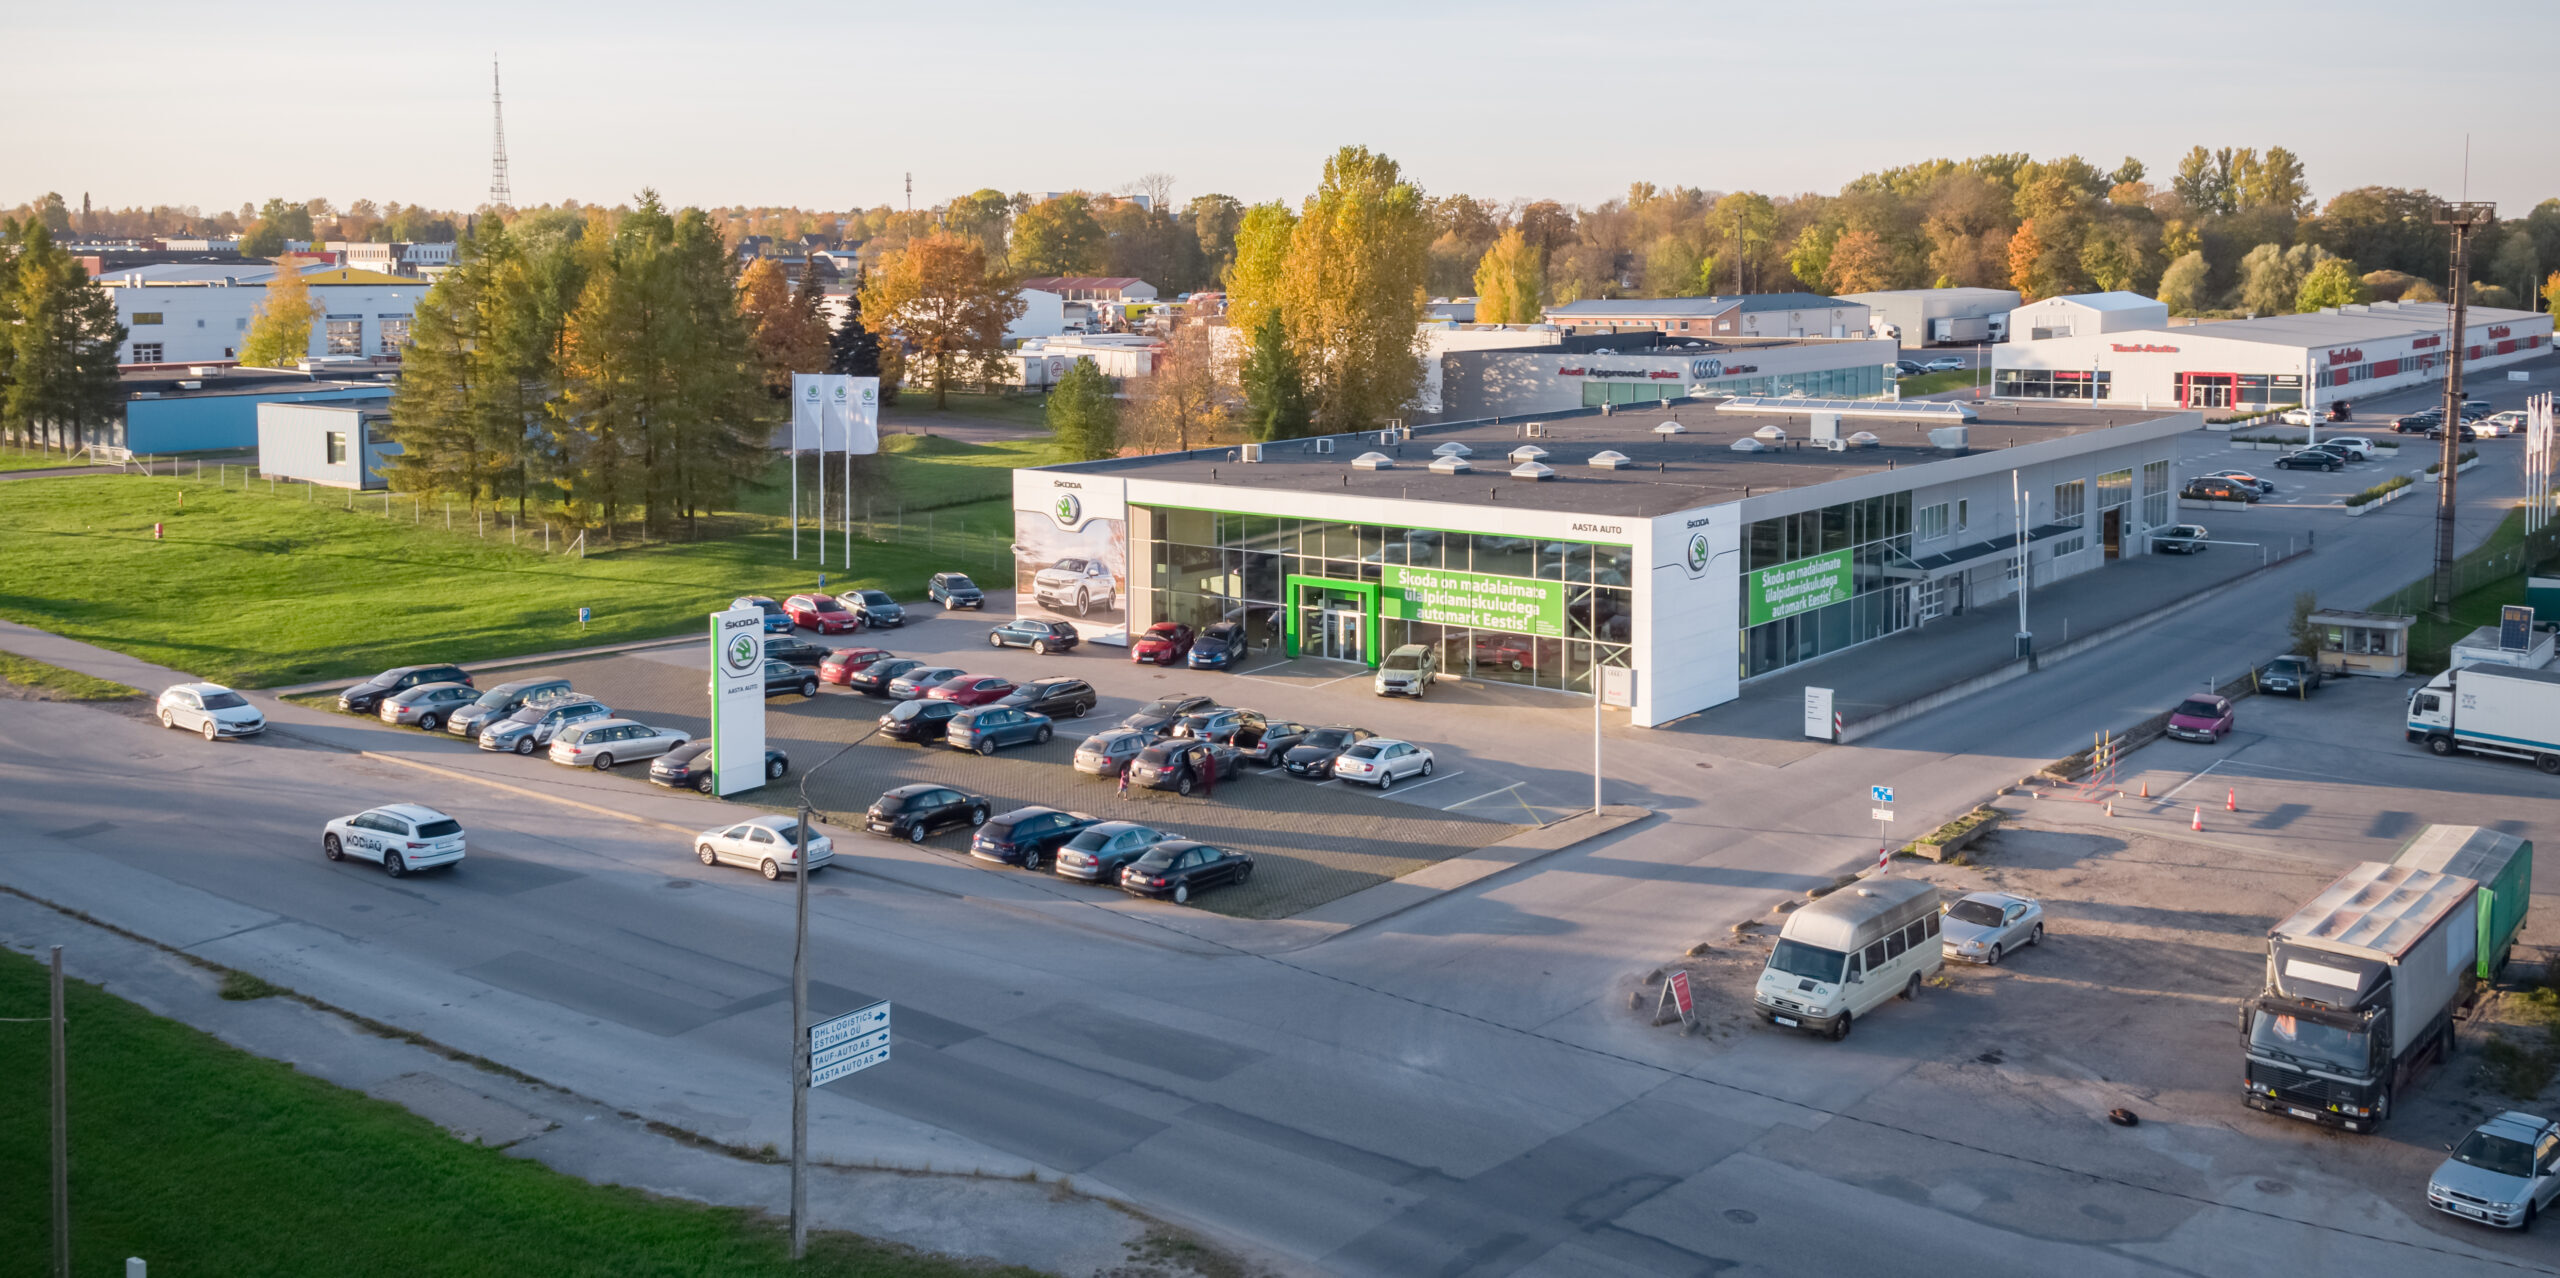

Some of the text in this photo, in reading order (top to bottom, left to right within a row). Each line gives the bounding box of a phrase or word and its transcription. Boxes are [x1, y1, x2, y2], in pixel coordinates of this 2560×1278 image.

[1558, 367, 1585, 376] Audi
[1588, 368, 1646, 378] Approved
[1572, 523, 1622, 534] AASTA AUTO
[1398, 568, 1547, 600] Škoda on madalaimate
[1762, 558, 1841, 588] Škoda on madalaimate
[1405, 587, 1540, 618] ülalpidamiskuludega
[1765, 574, 1838, 603] ülalpidamiskuludega
[1772, 596, 1807, 618] automark
[1808, 588, 1831, 607] Eestis!
[1416, 607, 1480, 626] automark
[1483, 613, 1529, 631] Eestis!
[814, 1011, 873, 1039] DHL LOGISTICS
[814, 1025, 861, 1049] ESTONIA OÜ
[815, 1039, 870, 1066] TAUF-AUTO AS
[813, 1054, 874, 1083] AASTA AUTO AS
